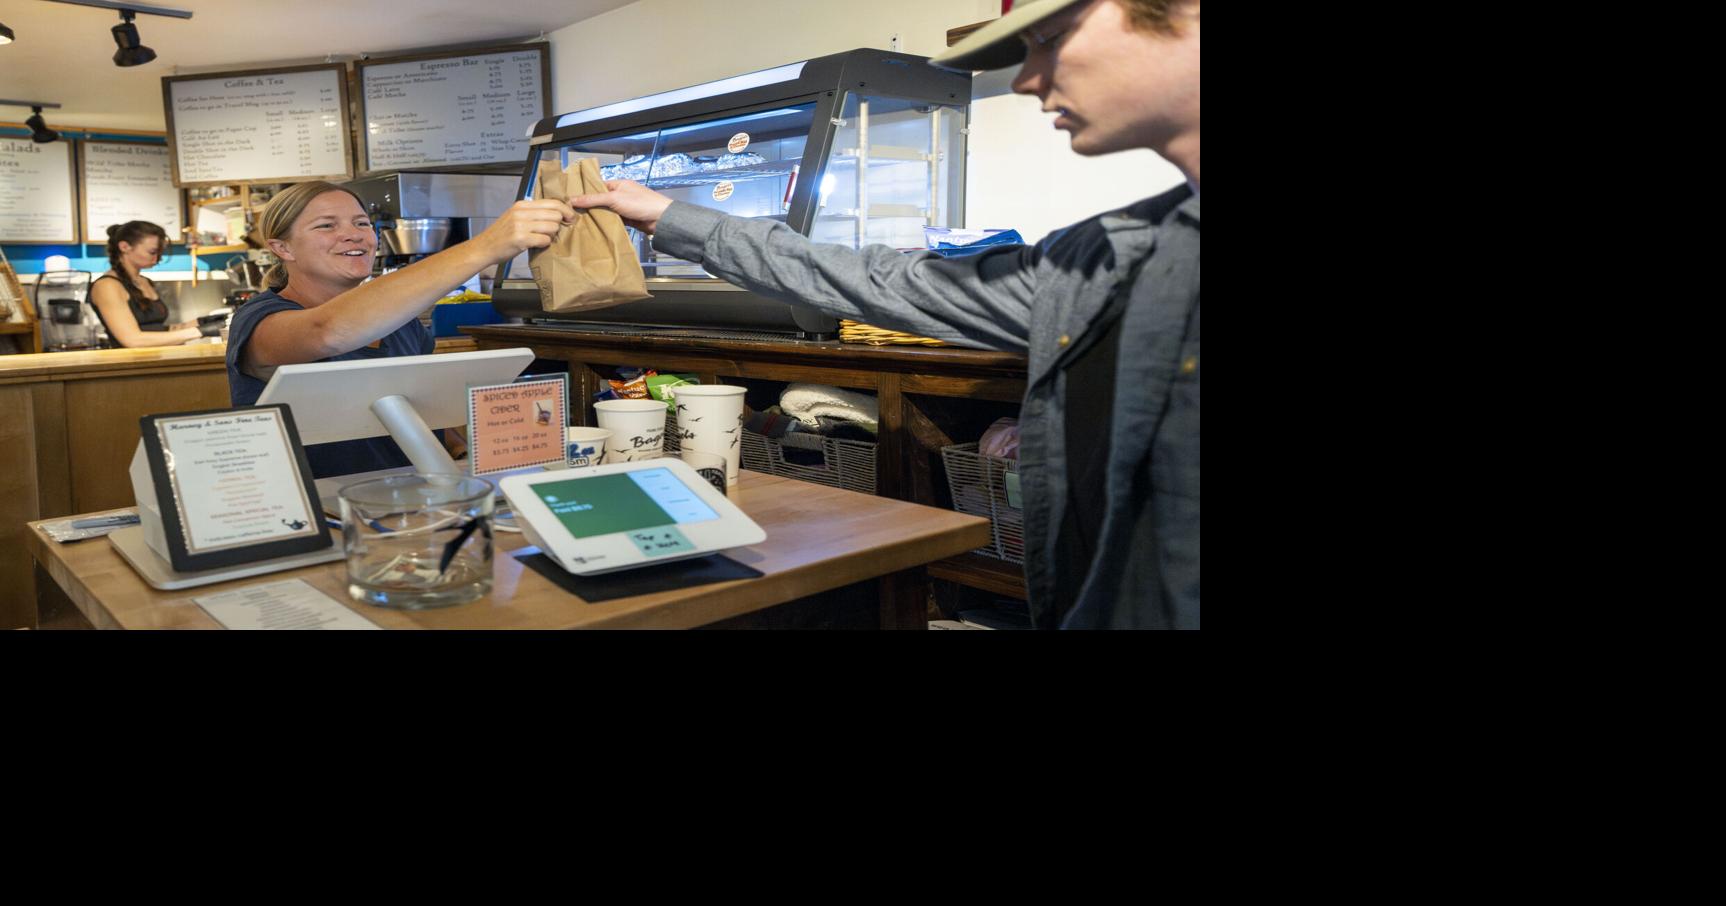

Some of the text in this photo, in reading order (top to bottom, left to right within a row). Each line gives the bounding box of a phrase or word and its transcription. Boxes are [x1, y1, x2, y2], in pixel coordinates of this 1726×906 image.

[420, 58, 478, 71] Espresso Bar
[224, 80, 253, 88] Coffee
[256, 78, 264, 86] &
[92, 145, 132, 154] Blended
[520, 387, 553, 398] APPLE
[630, 433, 664, 448] Bag
